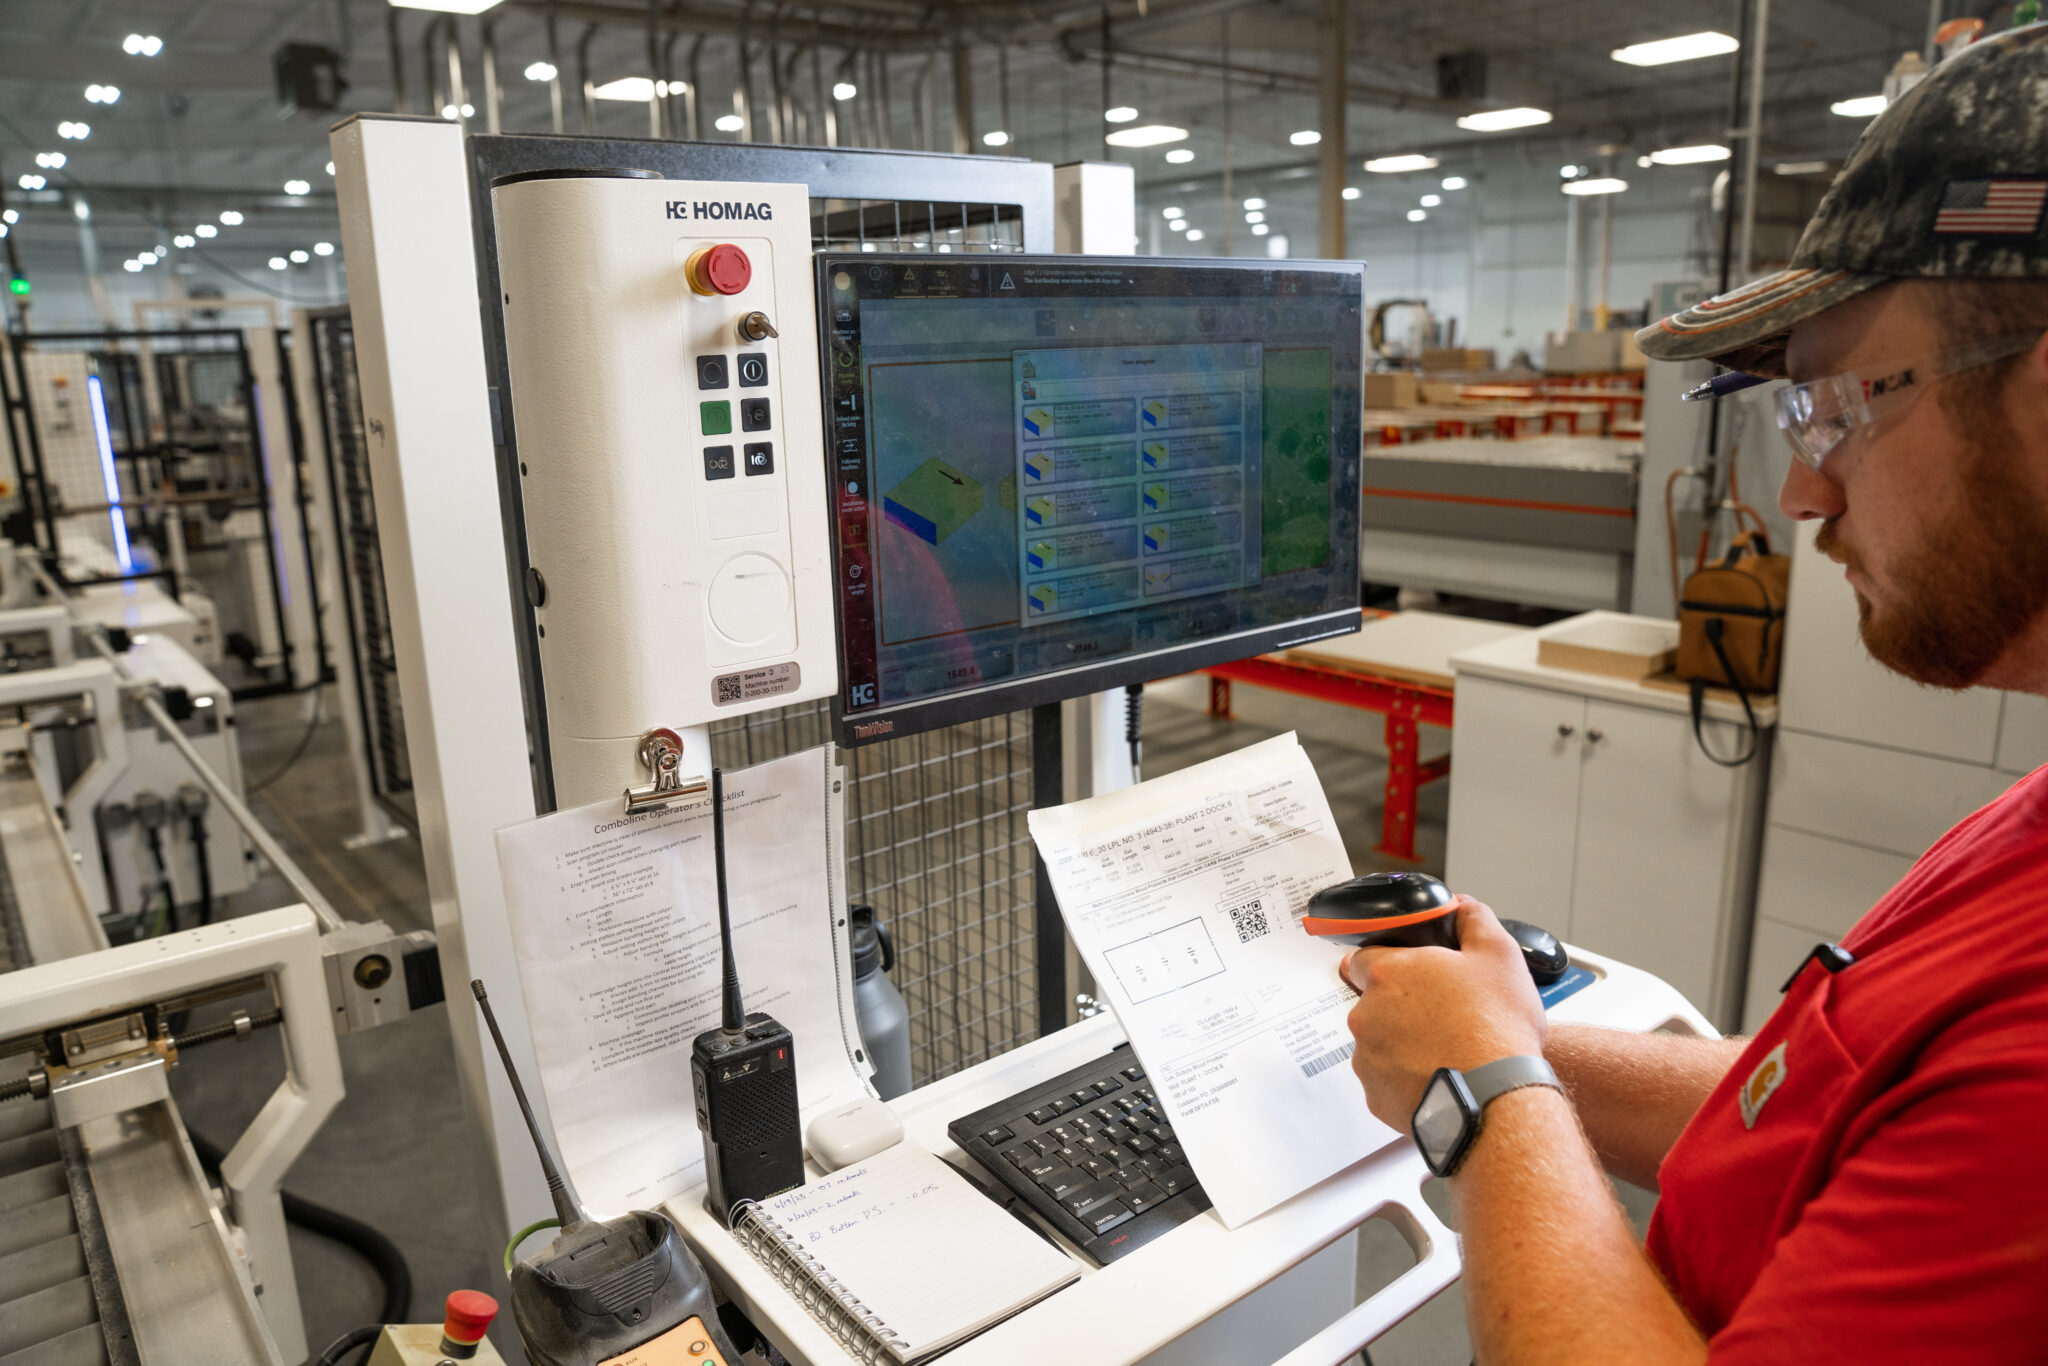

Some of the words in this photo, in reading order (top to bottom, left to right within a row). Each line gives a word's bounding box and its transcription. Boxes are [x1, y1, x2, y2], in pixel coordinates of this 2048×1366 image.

[693, 201, 772, 220] HOMAG
[744, 671, 766, 682] Service
[745, 680, 768, 690] Machine
[768, 676, 791, 688] number:
[744, 685, 784, 698] 0-200-30-1311
[853, 720, 894, 740] ThinkVision
[594, 813, 647, 834] Comboline
[650, 801, 701, 819] Operators
[703, 789, 744, 806] Ccklist
[1107, 840, 1121, 851] LPL
[1143, 821, 1175, 838] (4943-38)
[1176, 811, 1198, 825] PLANT
[1200, 808, 1205, 817] 2
[1205, 803, 1227, 815] DOCK
[1203, 860, 1217, 869] CARB
[1106, 1126, 1116, 1134] E
[1084, 1136, 1095, 1144] W
[1118, 1170, 1127, 1178] Z
[774, 1193, 806, 1209] 6/19/23
[787, 1208, 818, 1222] 6/20/23
[1095, 1214, 1117, 1226] CONTROL
